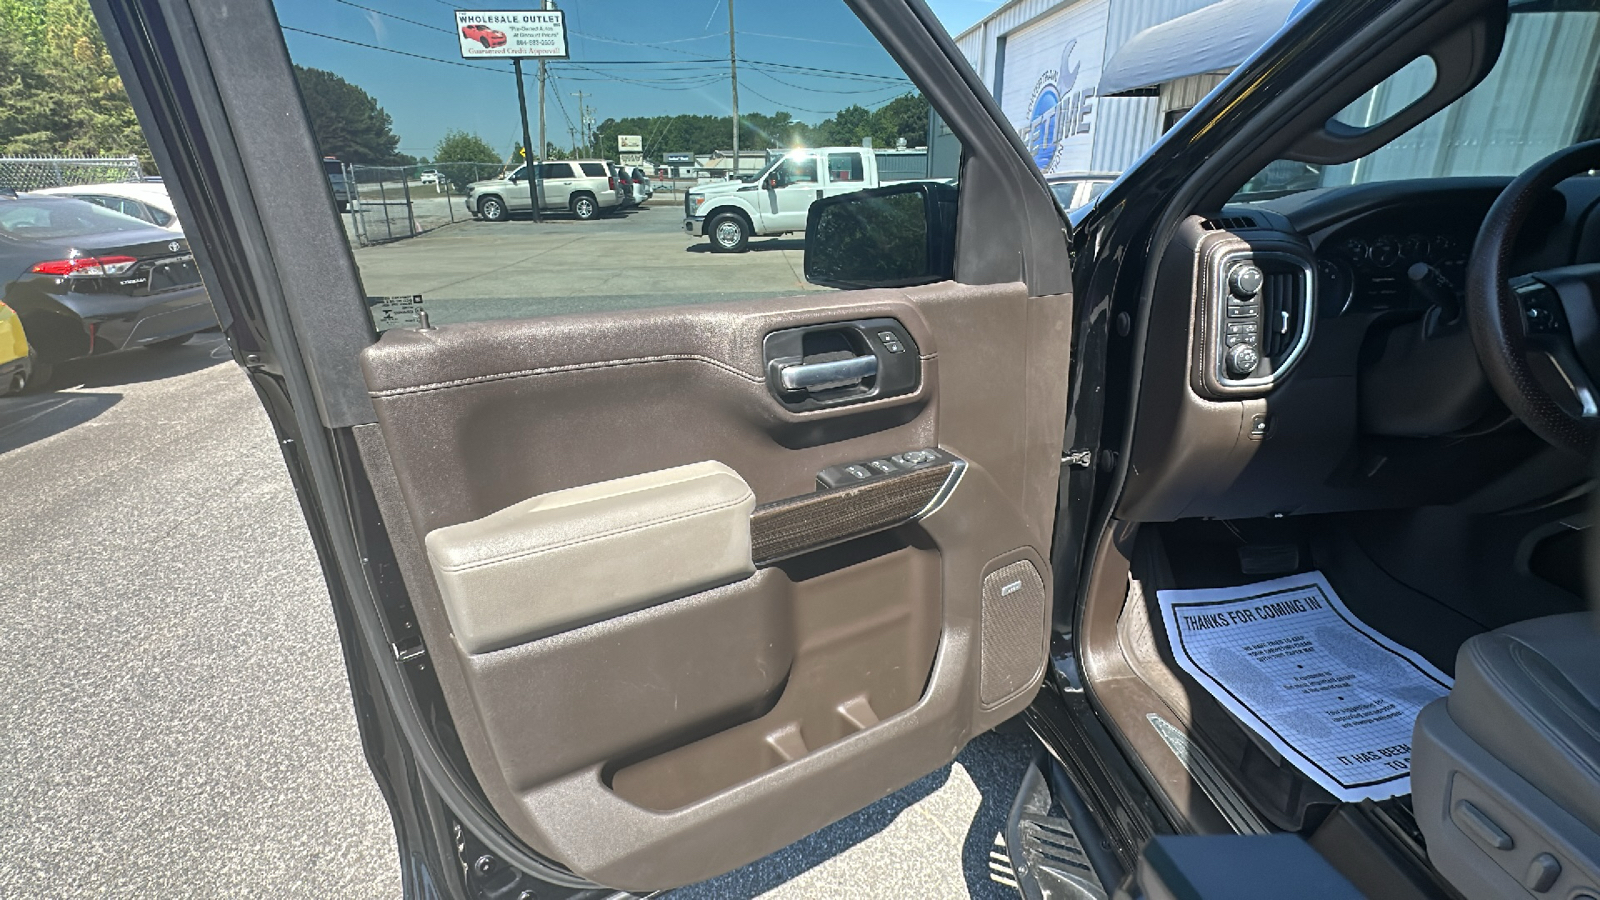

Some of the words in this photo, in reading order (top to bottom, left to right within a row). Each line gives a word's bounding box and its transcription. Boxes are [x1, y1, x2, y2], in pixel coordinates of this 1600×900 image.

[459, 15, 519, 23] WHOLESALE
[523, 15, 560, 23] OUTLET
[1183, 612, 1230, 631] THANKS
[1227, 609, 1257, 625] FOR
[1256, 599, 1307, 619] COMING
[1304, 595, 1322, 611] IN
[1337, 756, 1354, 766] IT
[1351, 751, 1382, 763] HAS
[1384, 759, 1408, 771] TO
